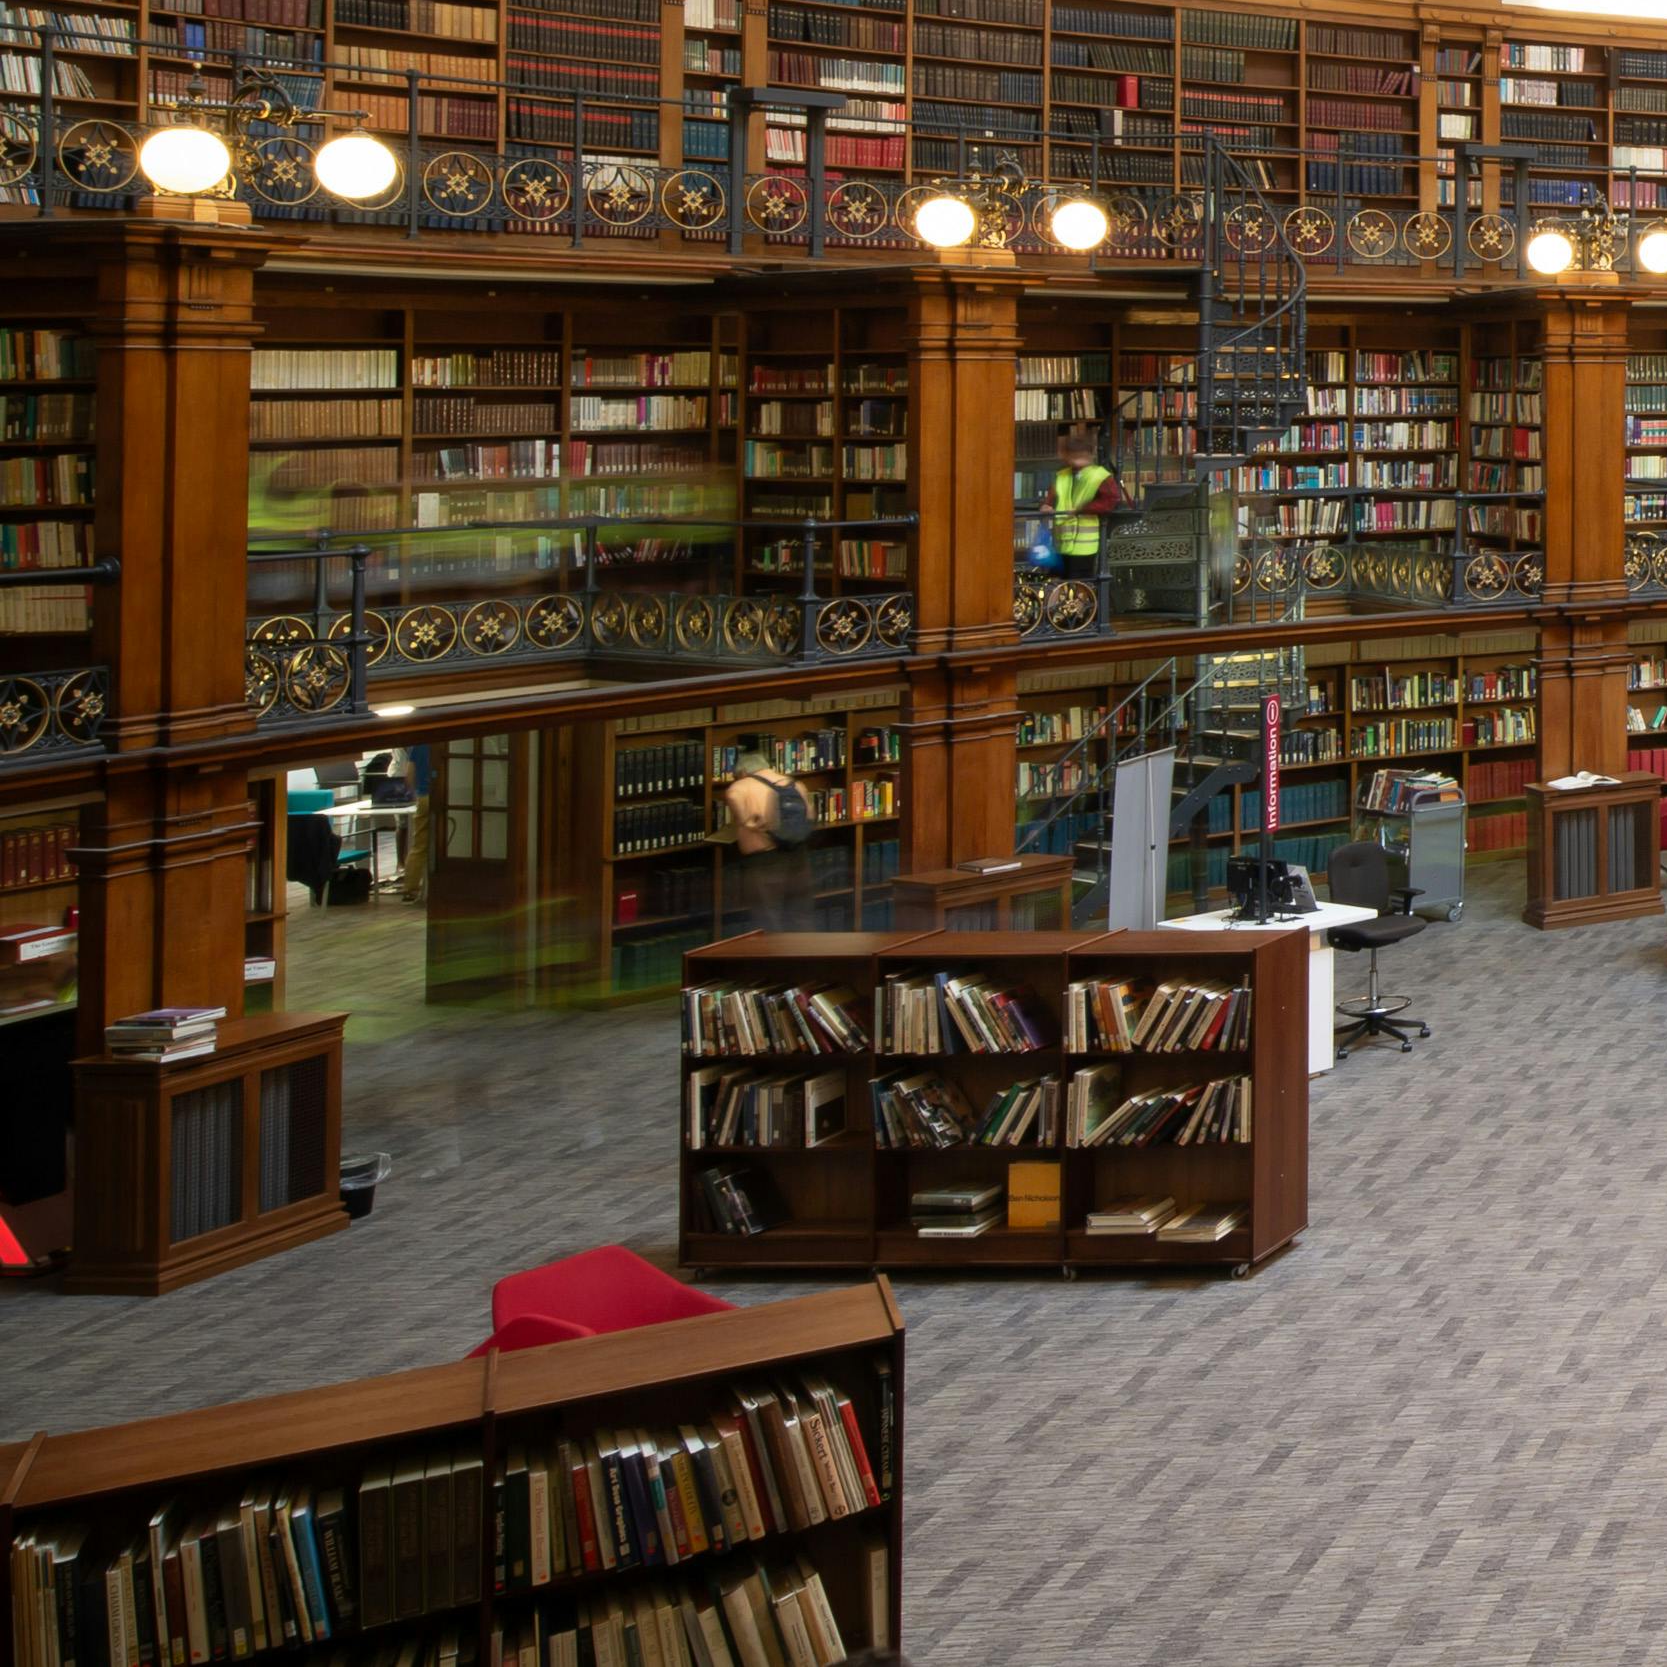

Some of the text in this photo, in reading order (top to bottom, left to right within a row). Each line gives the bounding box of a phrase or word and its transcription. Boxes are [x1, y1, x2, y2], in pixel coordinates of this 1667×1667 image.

[1268, 727, 1277, 829] Information
[810, 1418, 828, 1461] Sickert
[323, 1528, 339, 1571] WILLIAM
